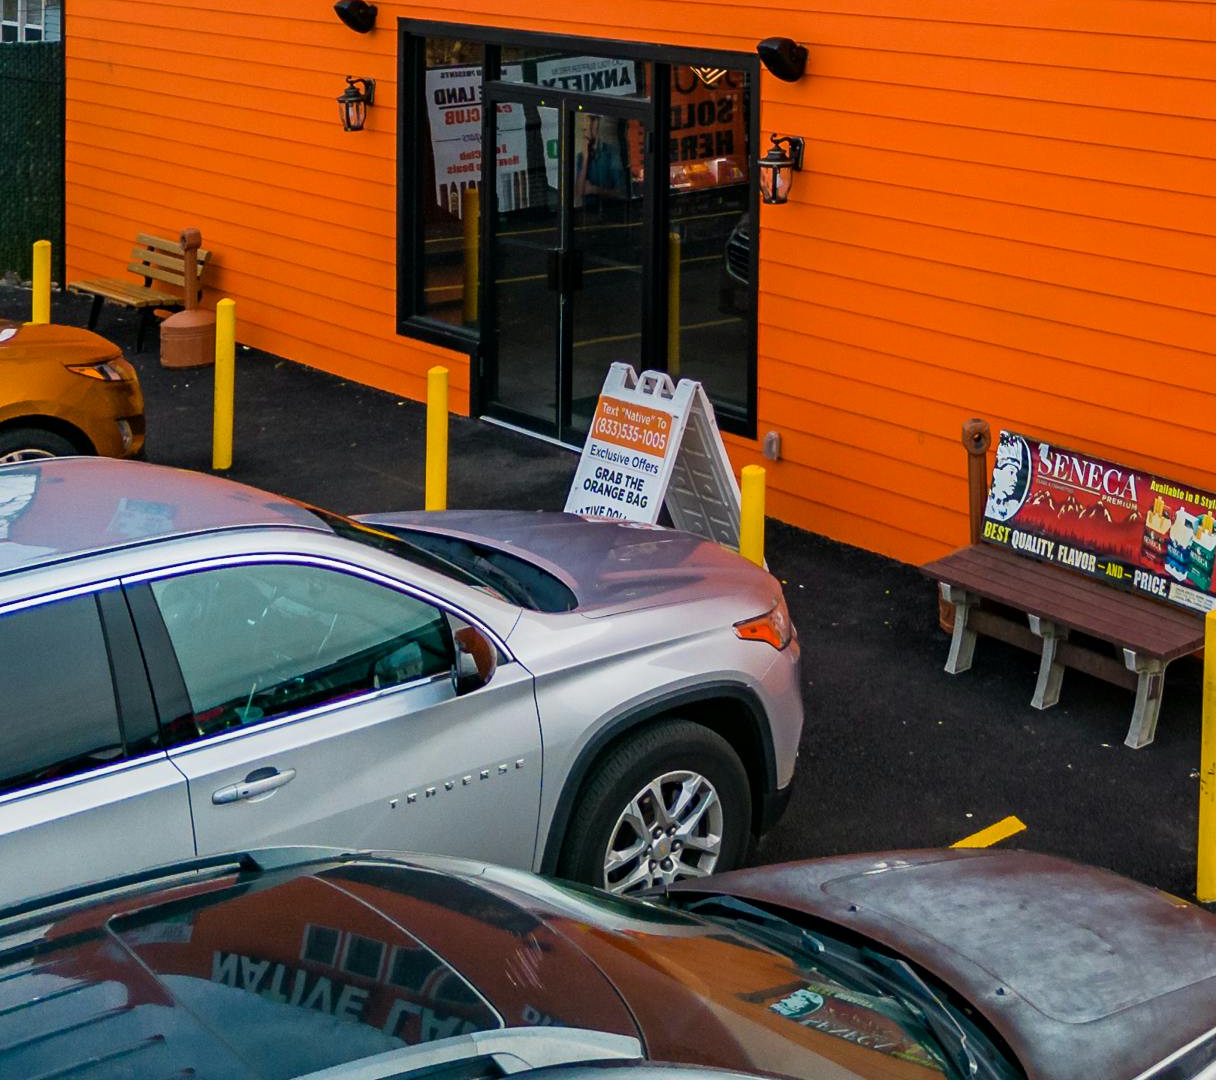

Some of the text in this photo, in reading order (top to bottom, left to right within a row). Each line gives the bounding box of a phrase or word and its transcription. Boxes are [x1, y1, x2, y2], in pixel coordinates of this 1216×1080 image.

[602, 402, 667, 429] Text "Native" To
[595, 417, 667, 450] (833)535-1005
[590, 444, 659, 475] Exclusive Offers
[1038, 443, 1138, 502] SENECA
[583, 479, 648, 508] ORANGE BAG
[595, 467, 645, 492] GRAB THE
[1150, 480, 1184, 500] Available
[575, 505, 605, 517] ATIVE
[1101, 494, 1138, 511] PREMIUM
[984, 521, 1011, 544] BEST
[1011, 530, 1054, 561] QUALITY,
[1057, 545, 1097, 572] FLAVOR
[1133, 569, 1168, 598] PRICE.
[389, 759, 525, 809] TRAVERSE
